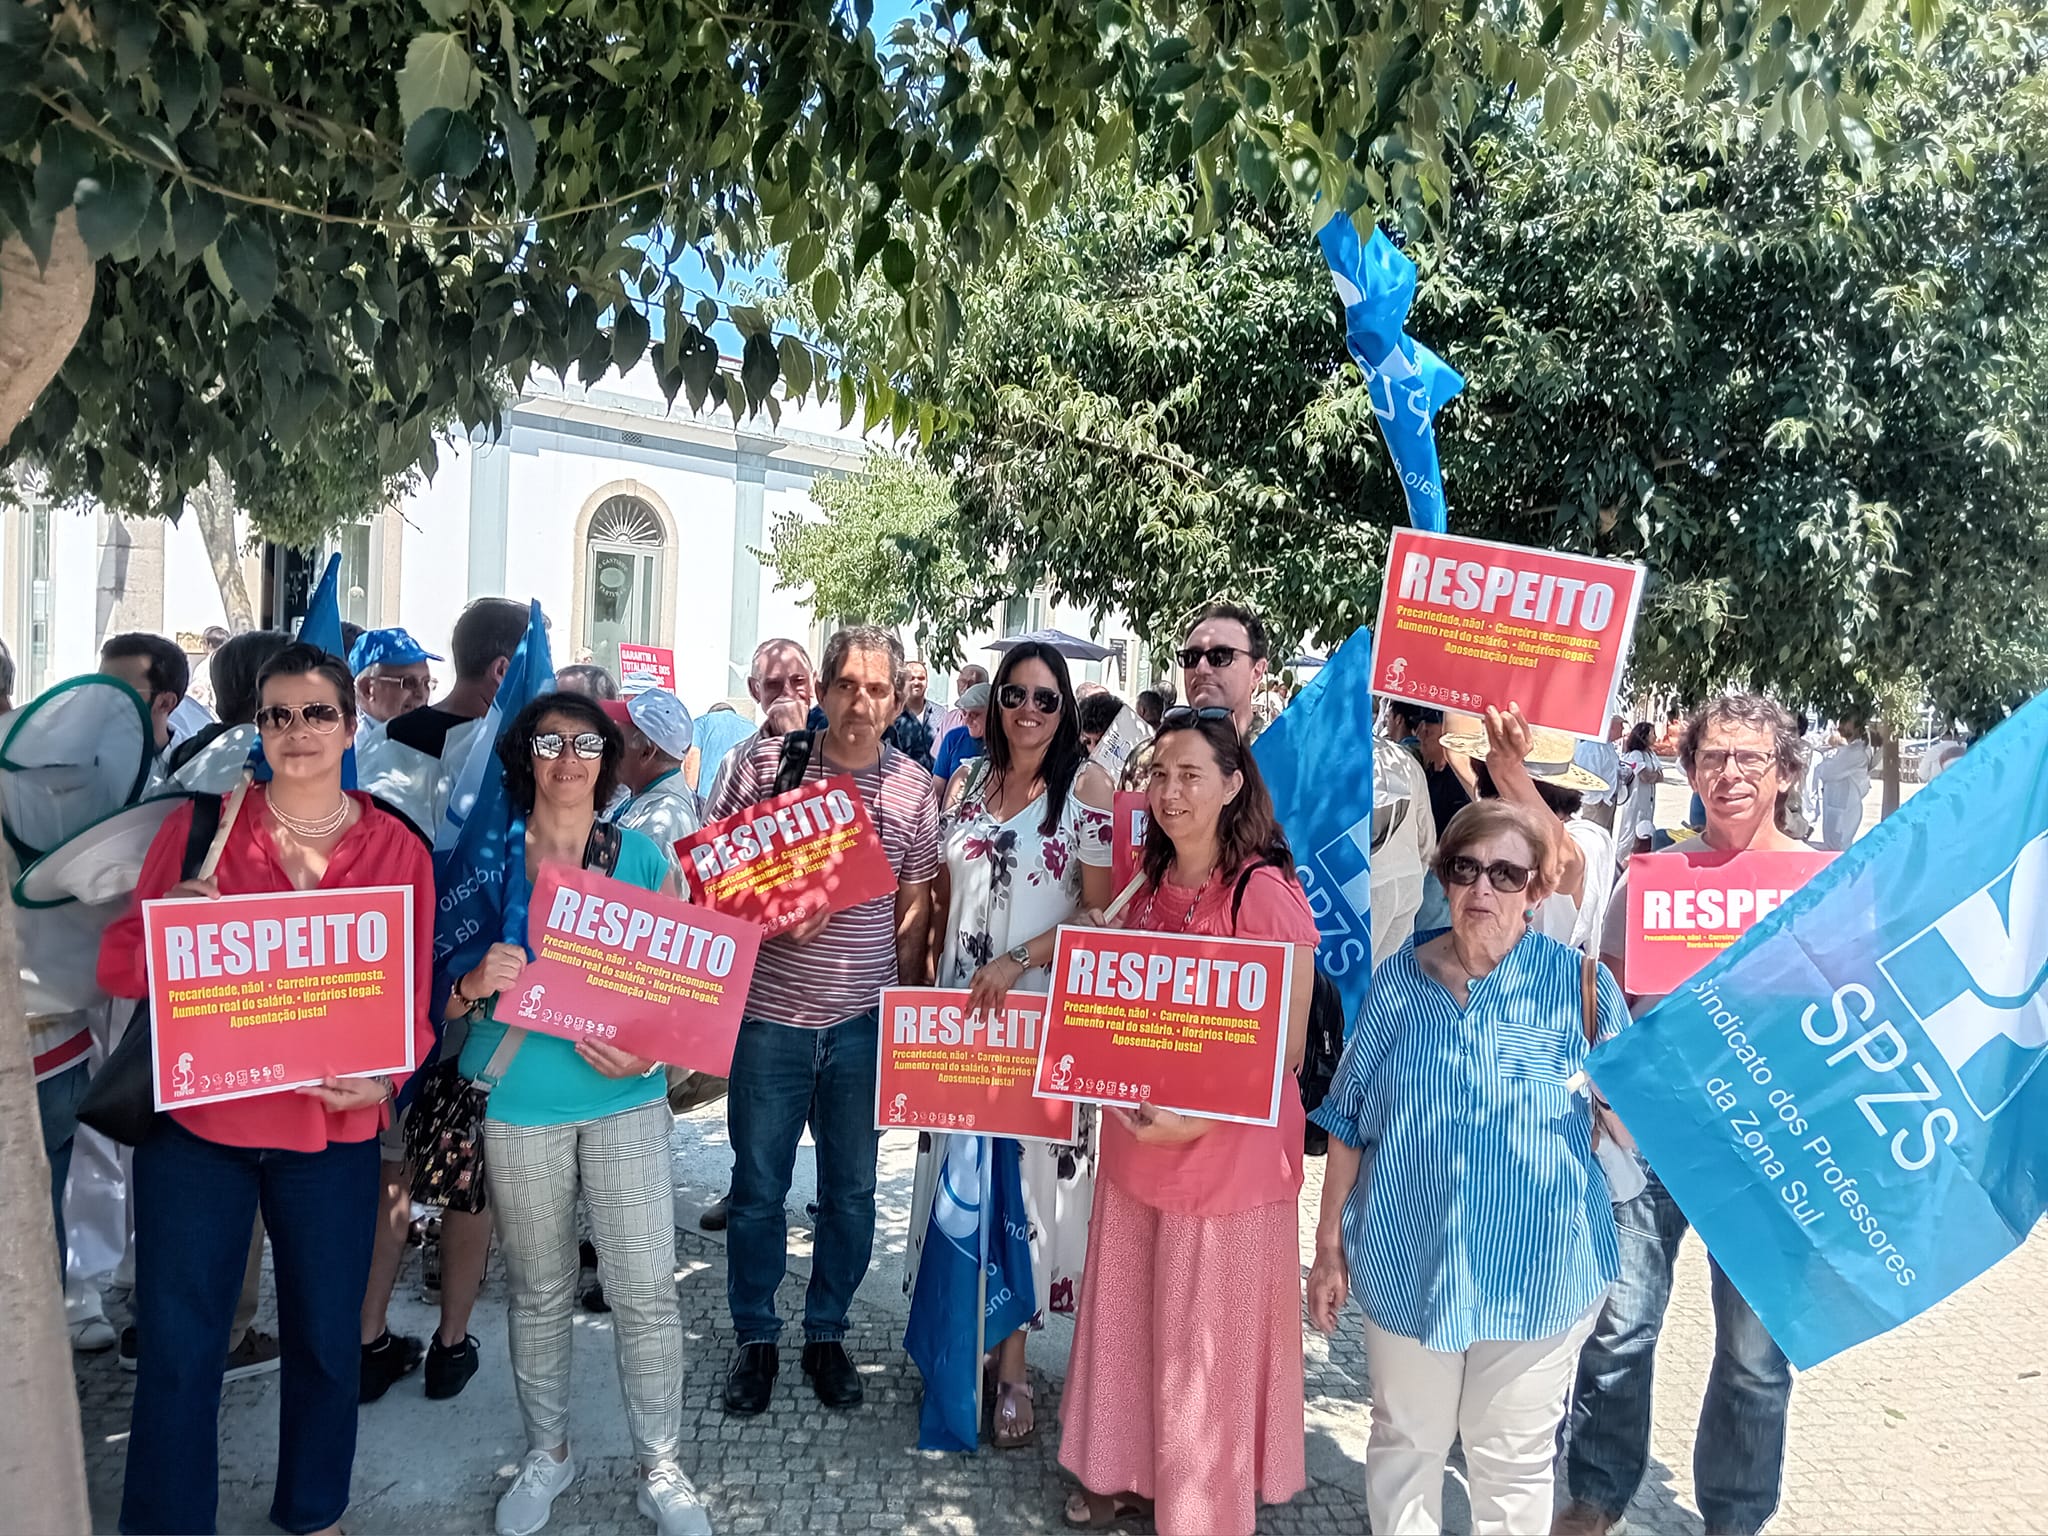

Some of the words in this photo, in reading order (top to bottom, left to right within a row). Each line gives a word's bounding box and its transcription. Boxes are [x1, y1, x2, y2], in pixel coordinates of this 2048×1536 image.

[1398, 552, 1615, 632] RESPEITO
[1397, 605, 1461, 627] Precariedade,
[1462, 616, 1485, 630] não!
[1495, 622, 1538, 640] Carreira
[1539, 631, 1601, 650] recomposta.
[1397, 619, 1438, 636] Aumento
[1439, 627, 1458, 640] real
[1459, 630, 1472, 643] do
[1473, 632, 1510, 649] salário.
[1517, 640, 1561, 657] Horários
[1561, 648, 1595, 664] legais.
[1444, 642, 1507, 663] Aposentação
[1508, 653, 1538, 669] justa!
[690, 789, 856, 883] RESPEITO
[1643, 888, 1795, 930] RESPE
[164, 911, 388, 981] RESPEITO
[547, 885, 736, 977] RESPEITO
[541, 948, 581, 967] Aumento
[582, 958, 601, 972] real
[601, 963, 613, 975] do
[614, 967, 646, 986] salário.
[652, 979, 691, 998] Horários
[691, 988, 720, 1006] legais.
[542, 934, 604, 960] Precariedade,
[606, 952, 626, 966] não!
[635, 961, 671, 981] Carreira
[671, 972, 725, 994] recomposta.
[1066, 948, 1268, 1012] RESPEITO
[169, 983, 240, 1003] Precariedade,
[241, 980, 264, 995] não!
[276, 977, 319, 991] Carreira
[321, 970, 386, 986] recomposta.
[172, 1002, 218, 1019] Aumento
[219, 999, 240, 1013] real
[242, 998, 255, 1010] do
[257, 994, 295, 1009] salário.
[303, 987, 347, 1003] Horários
[348, 984, 384, 1000] legais.
[586, 973, 644, 999] Aposentação
[644, 988, 671, 1005] justa!
[230, 1008, 296, 1028] Aposentação
[297, 1005, 327, 1020] justa!
[893, 1006, 1041, 1049] RESPEIT
[1064, 1001, 1127, 1018] Precariedade,
[1128, 1006, 1149, 1019] não!
[1160, 1009, 1199, 1024] Carreira
[1200, 1016, 1261, 1031] recomposta.
[1064, 1015, 1104, 1029] Aumento
[1106, 1019, 1125, 1031] real
[1126, 1021, 1139, 1033] do
[1140, 1022, 1174, 1036] salário.
[1182, 1026, 1223, 1041] Horários
[1224, 1031, 1257, 1045] legais.
[893, 1050, 949, 1060] Precariedade,
[950, 1051, 968, 1060] não!
[977, 1052, 1010, 1064] Carreira
[1011, 1055, 1038, 1065] recom
[1112, 1034, 1173, 1050] Aposentação
[1174, 1040, 1202, 1053] justa!
[894, 1061, 930, 1070] Aumento
[932, 1061, 948, 1071] real
[949, 1063, 959, 1072] do
[960, 1063, 991, 1074] salário.
[997, 1065, 1031, 1077] Horários
[938, 1073, 990, 1086] Aposentação
[991, 1076, 1015, 1087] justa!
[1801, 982, 1959, 1171] SPZS
[1706, 1076, 1737, 1112] da
[1730, 1110, 1785, 1181] Zona
[1781, 1180, 1827, 1227] Sul
[1769, 1087, 1808, 1136] dos
[1803, 1135, 1916, 1287] Professores
